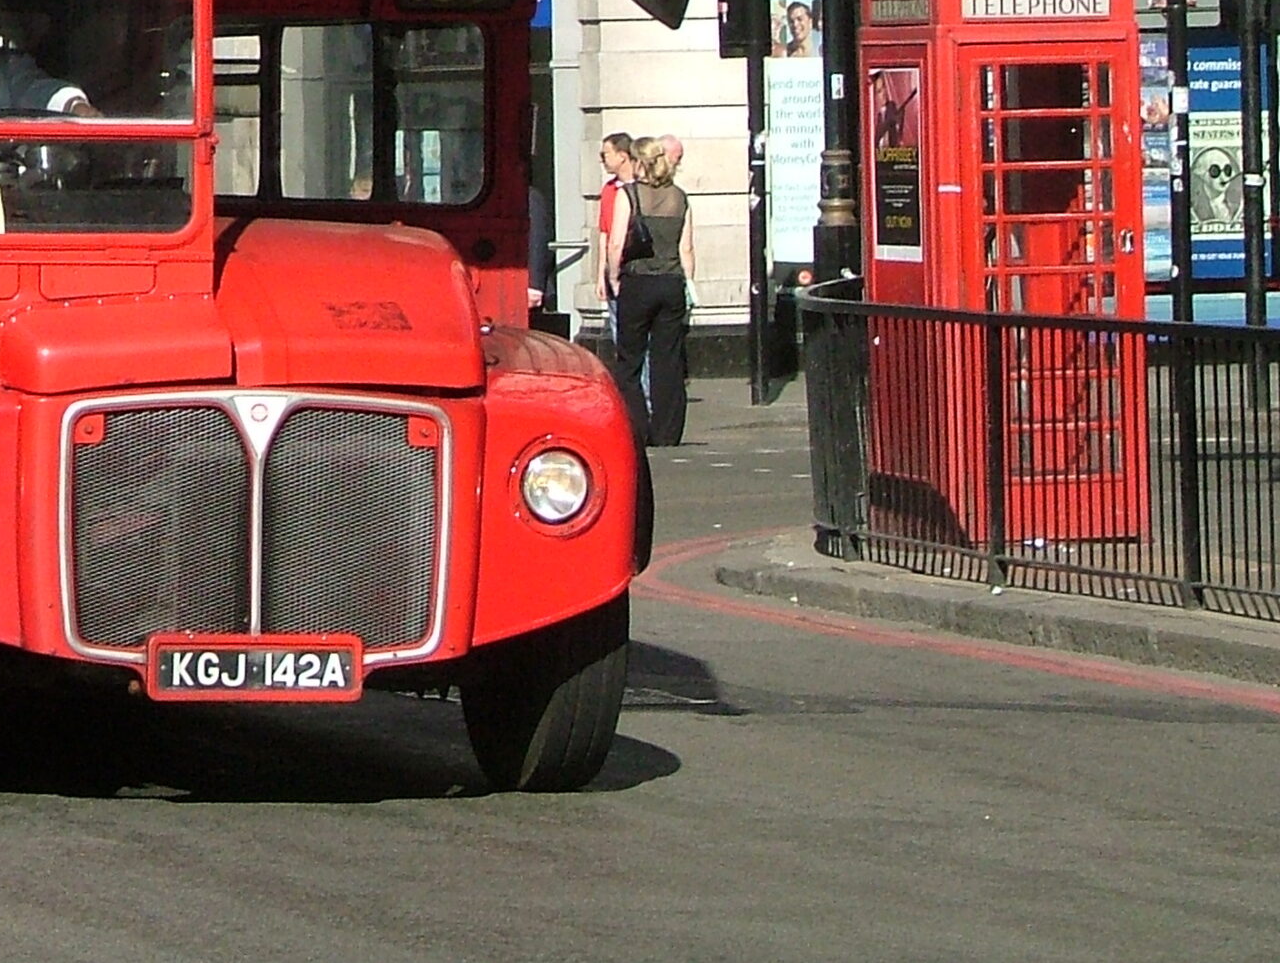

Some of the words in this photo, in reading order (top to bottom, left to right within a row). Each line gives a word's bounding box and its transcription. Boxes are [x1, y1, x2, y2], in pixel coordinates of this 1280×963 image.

[790, 137, 815, 149] with
[172, 652, 246, 687] KGJ
[265, 653, 346, 687] 142A
